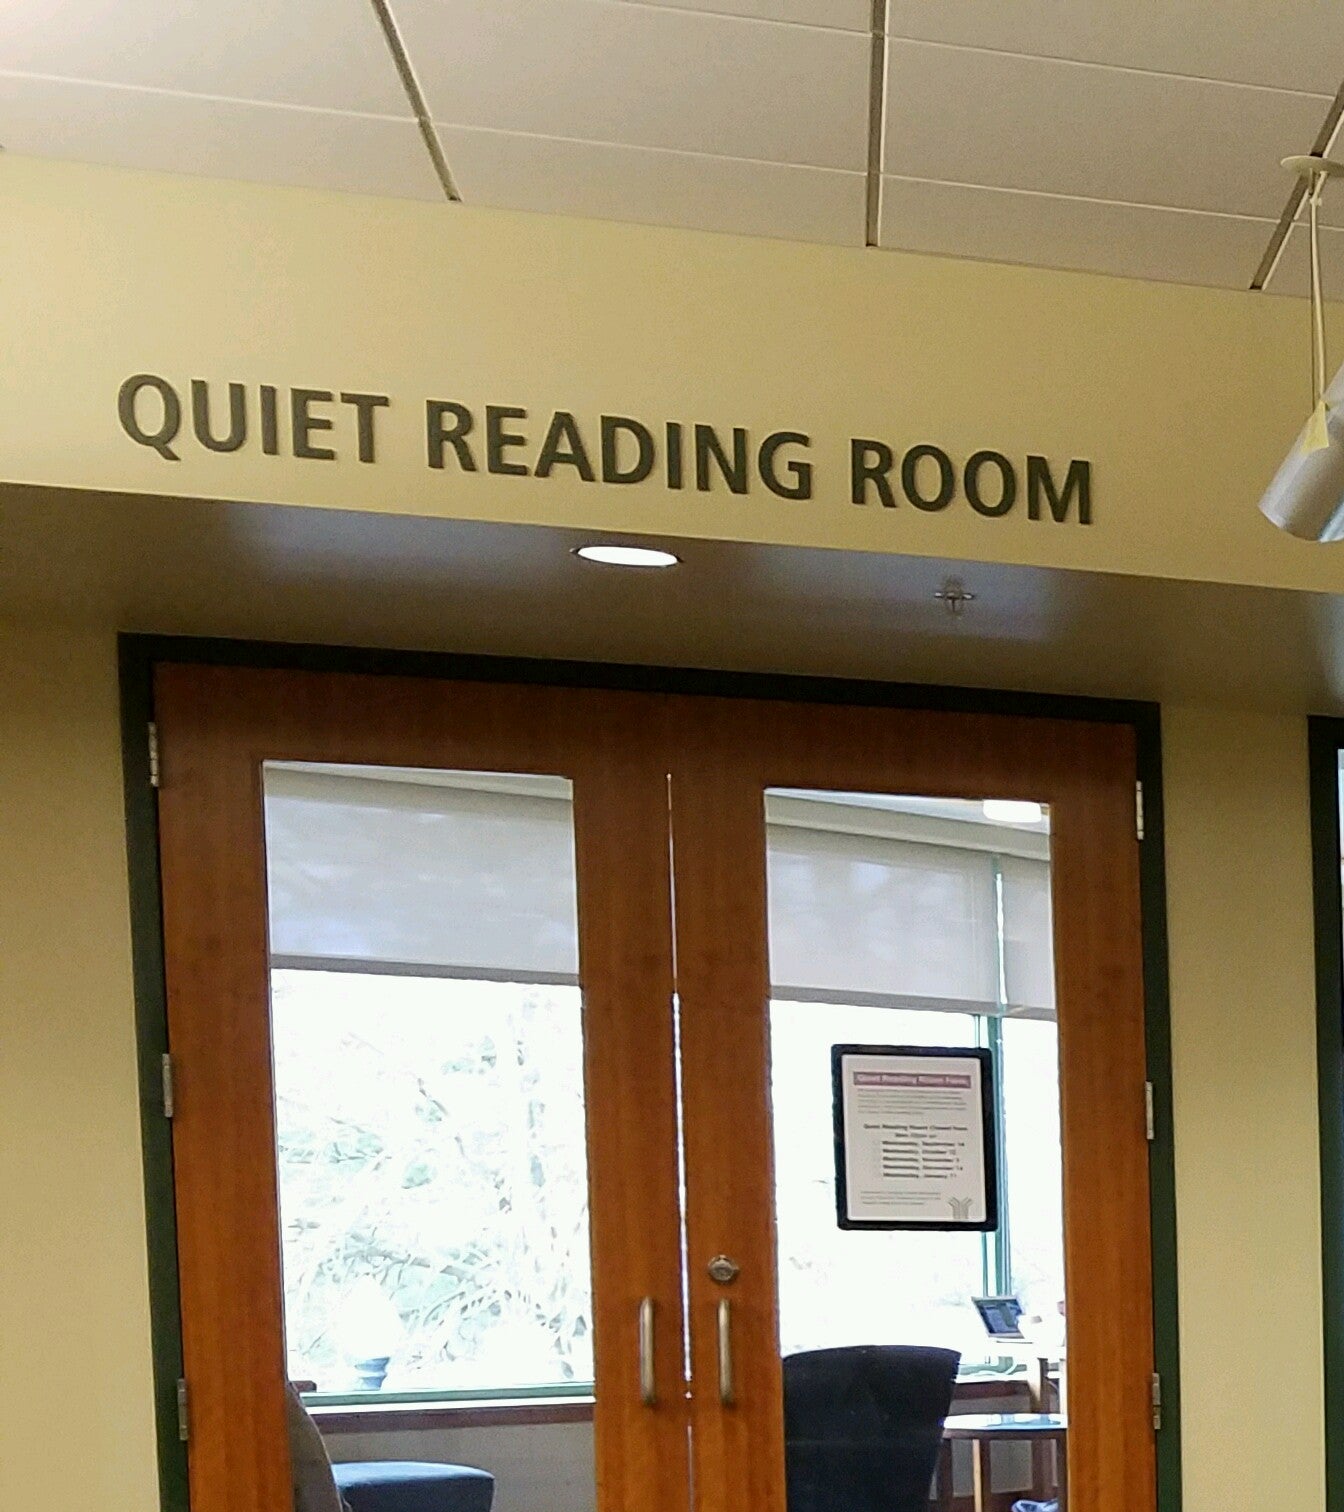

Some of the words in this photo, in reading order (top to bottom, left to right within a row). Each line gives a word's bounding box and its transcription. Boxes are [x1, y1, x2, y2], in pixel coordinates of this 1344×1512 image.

[116, 374, 389, 462] QUIET
[425, 400, 814, 500] READING
[849, 438, 1093, 525] ROOM
